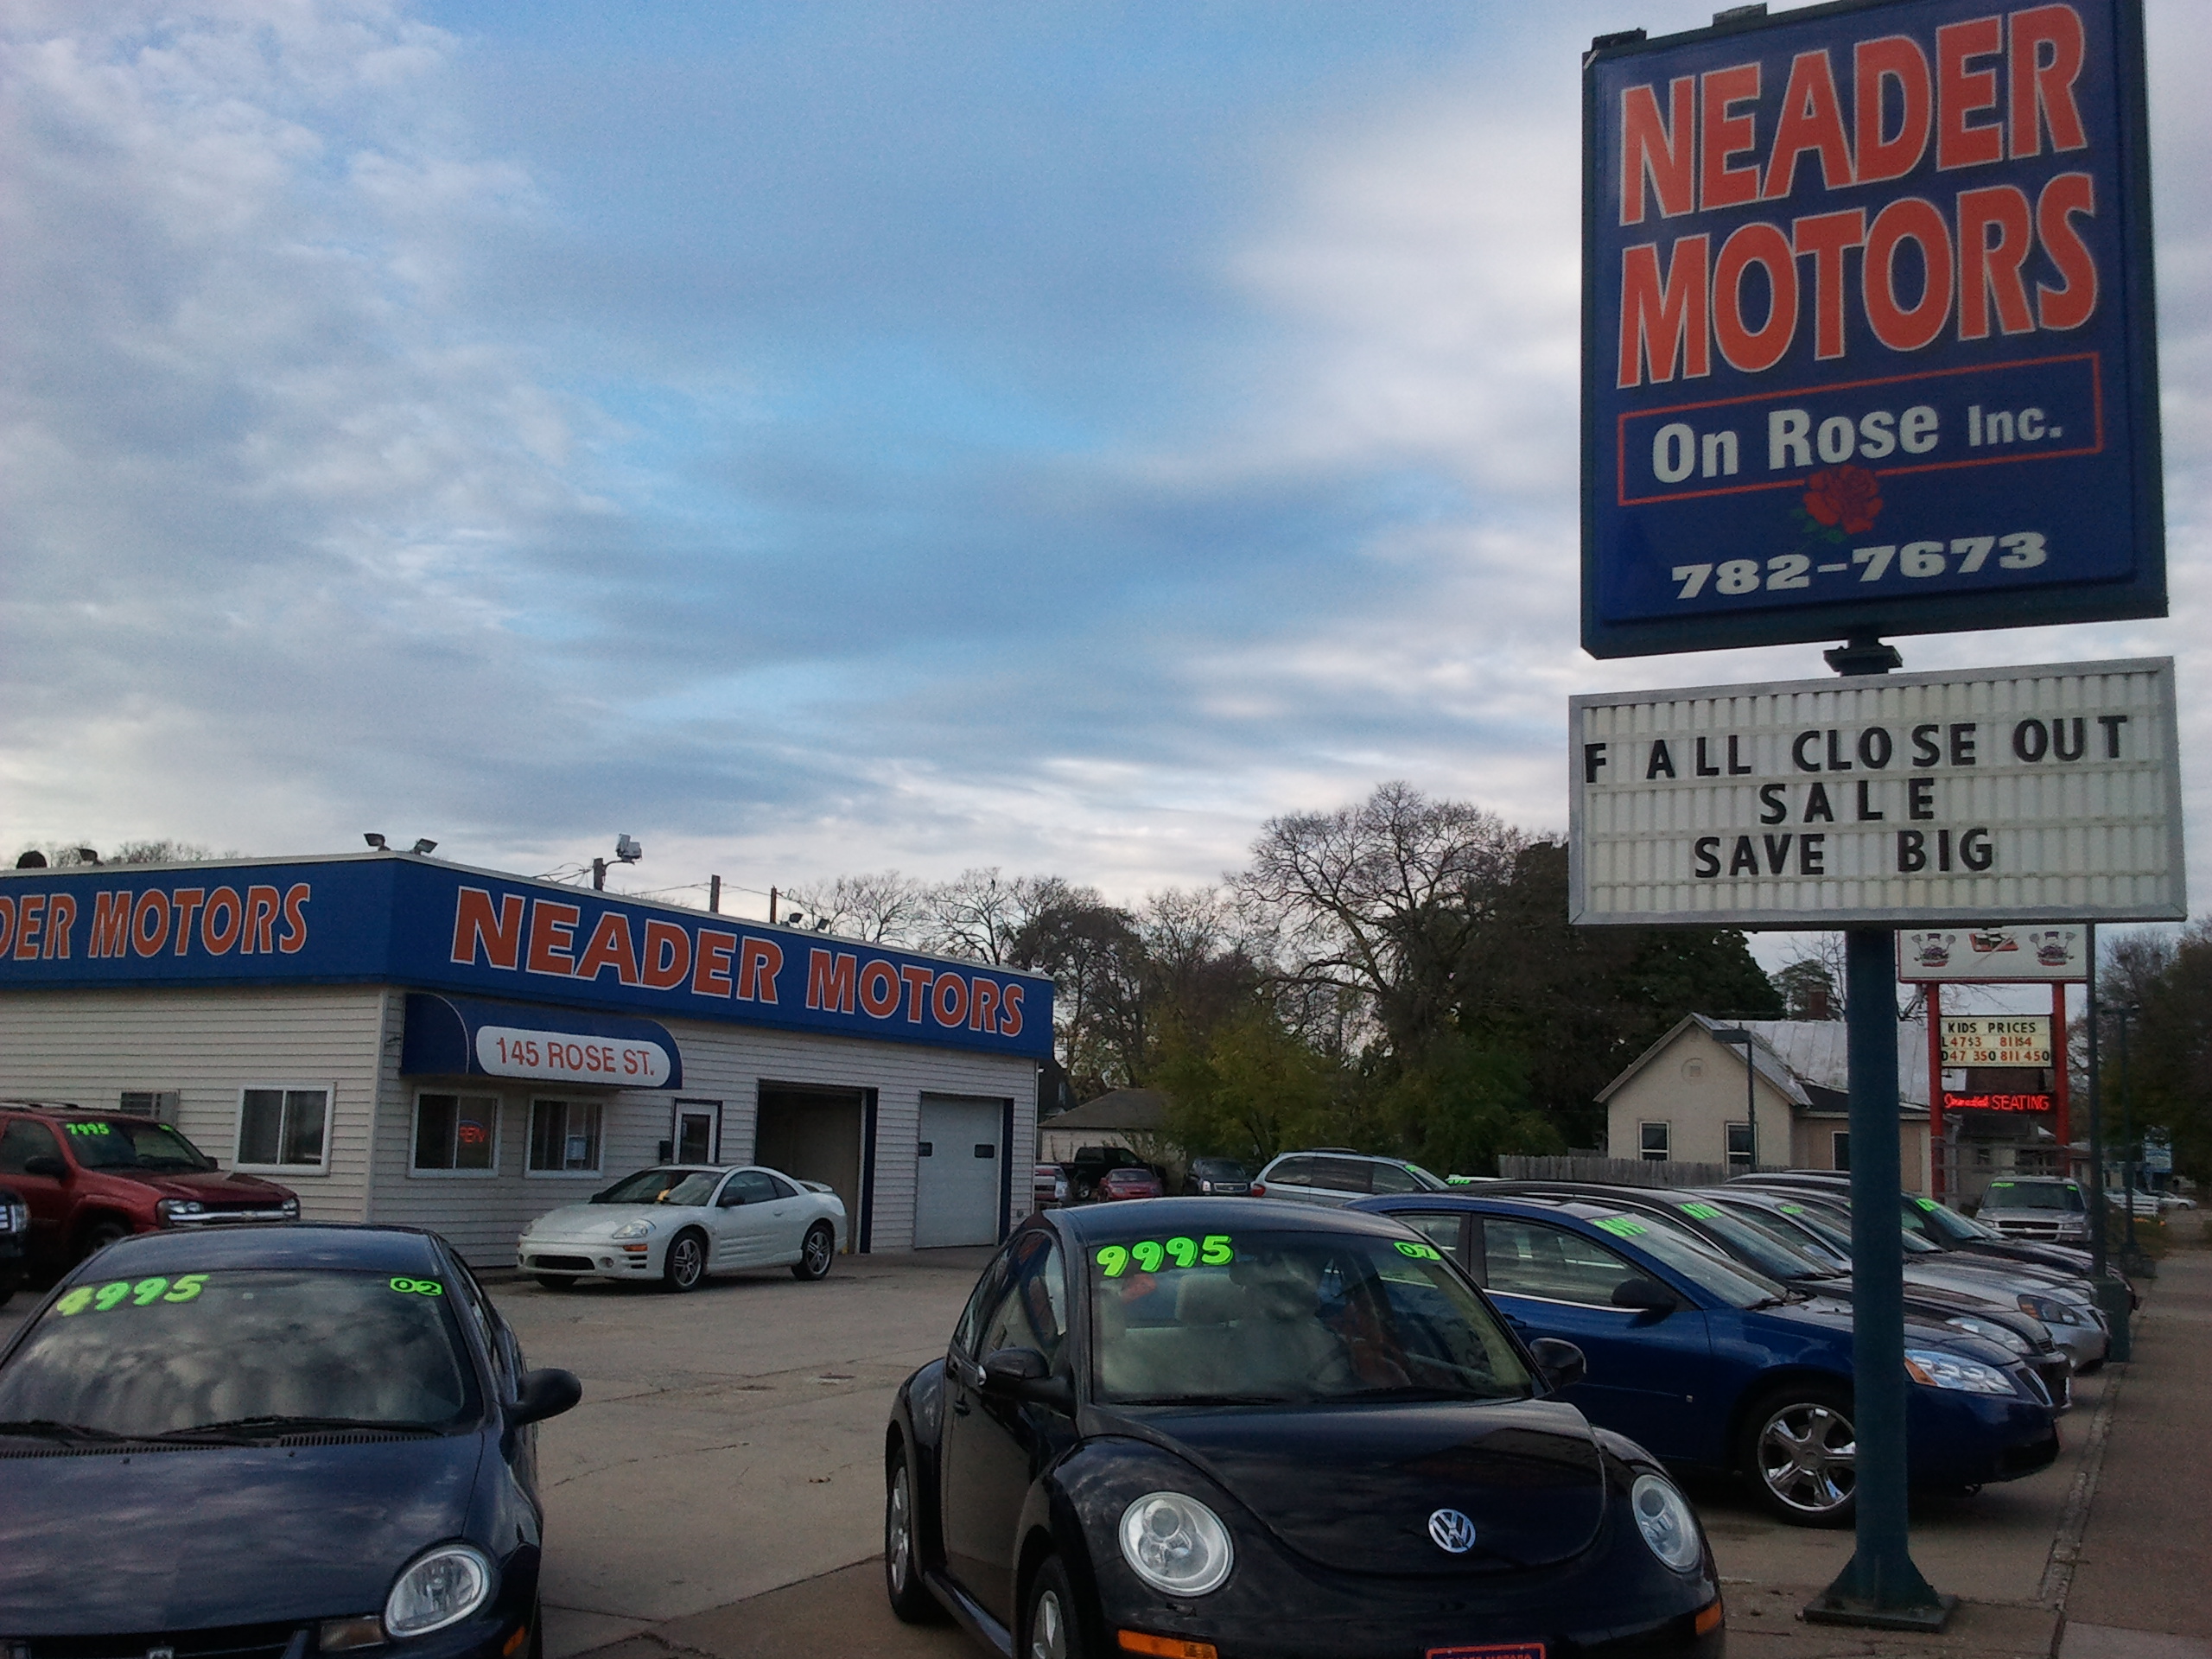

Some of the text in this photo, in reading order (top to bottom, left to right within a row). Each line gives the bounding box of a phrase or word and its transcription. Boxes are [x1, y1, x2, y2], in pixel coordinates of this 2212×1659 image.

[1619, 3, 2087, 226] NEADER
[1617, 173, 2098, 390] MOTORS
[1652, 404, 2063, 484] On Rose Inc.
[1671, 531, 2048, 601] 782-7673
[1791, 723, 1977, 772] CLOSE
[2013, 715, 2128, 762] OUT
[1759, 778, 1936, 824] SALE
[1694, 828, 1993, 879] SAVE BIG
[88, 883, 311, 958] MOTORS
[450, 885, 1026, 1038] NEADER MOTORS
[1948, 1022, 2037, 1033] KIDS PRICES
[496, 1037, 655, 1076] 145 ROSE ST.
[1991, 1095, 2050, 1111] SEATING
[1096, 1236, 1234, 1277] 9995
[1395, 1243, 1439, 1260] 07
[392, 1278, 441, 1295] 02
